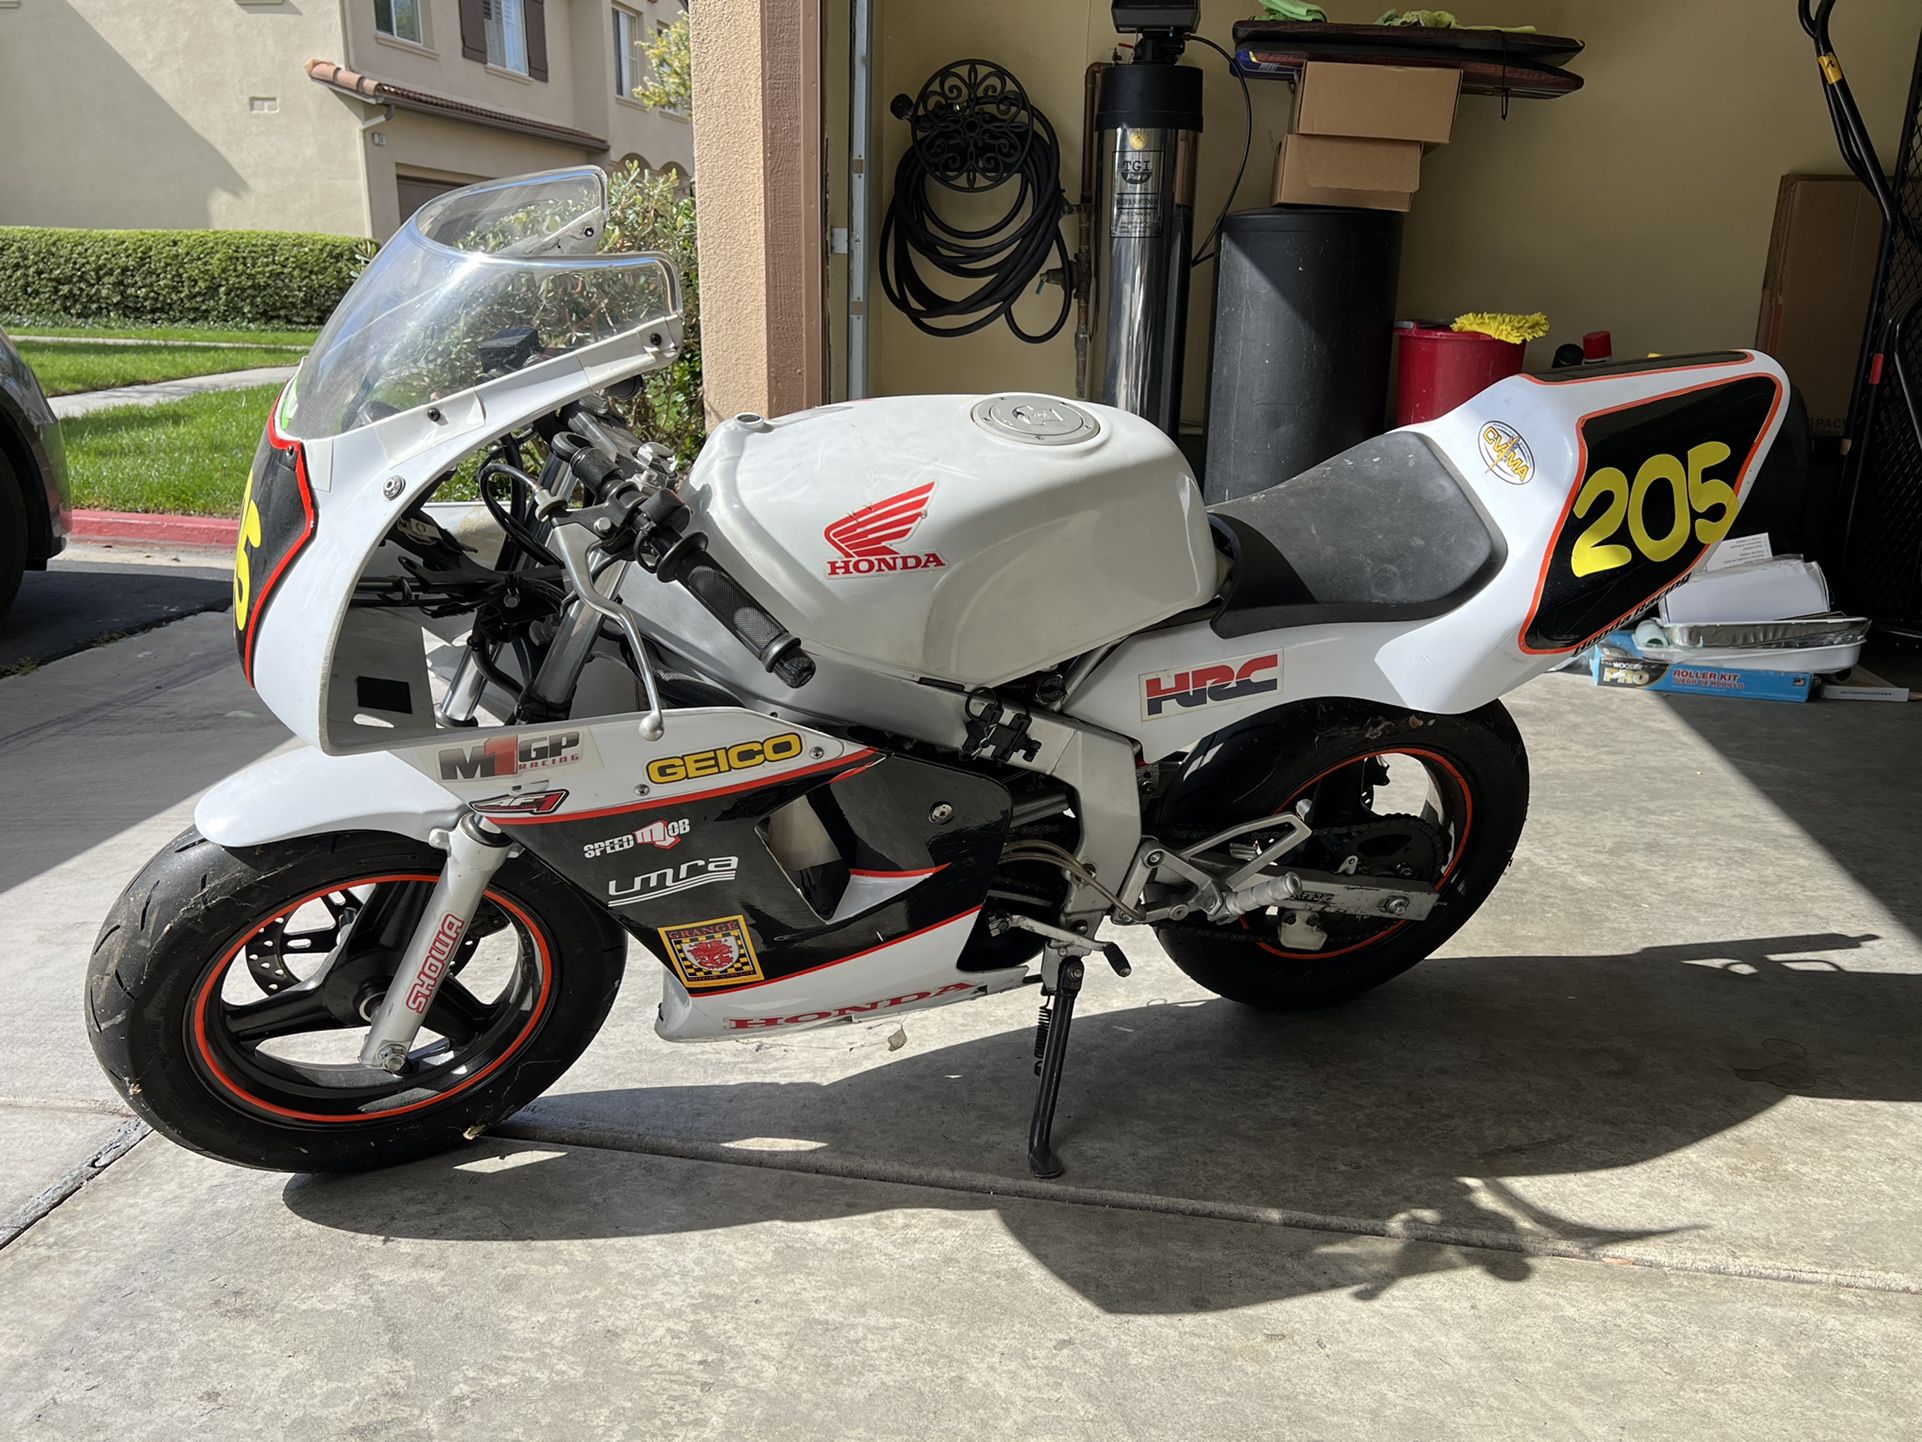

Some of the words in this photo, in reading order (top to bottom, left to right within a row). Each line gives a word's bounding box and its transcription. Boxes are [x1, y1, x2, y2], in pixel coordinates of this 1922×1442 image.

[1123, 160, 1152, 172] TGI
[1571, 441, 1740, 578] 205
[827, 552, 946, 576] HONDA
[1146, 654, 1278, 716] HRC
[1673, 669, 1718, 680] ROLLER
[1720, 672, 1740, 682] KIT
[518, 754, 581, 771] RACING
[646, 732, 803, 784] GEICO
[405, 913, 465, 1014] SHOWA
[728, 980, 980, 1031] HONDA
